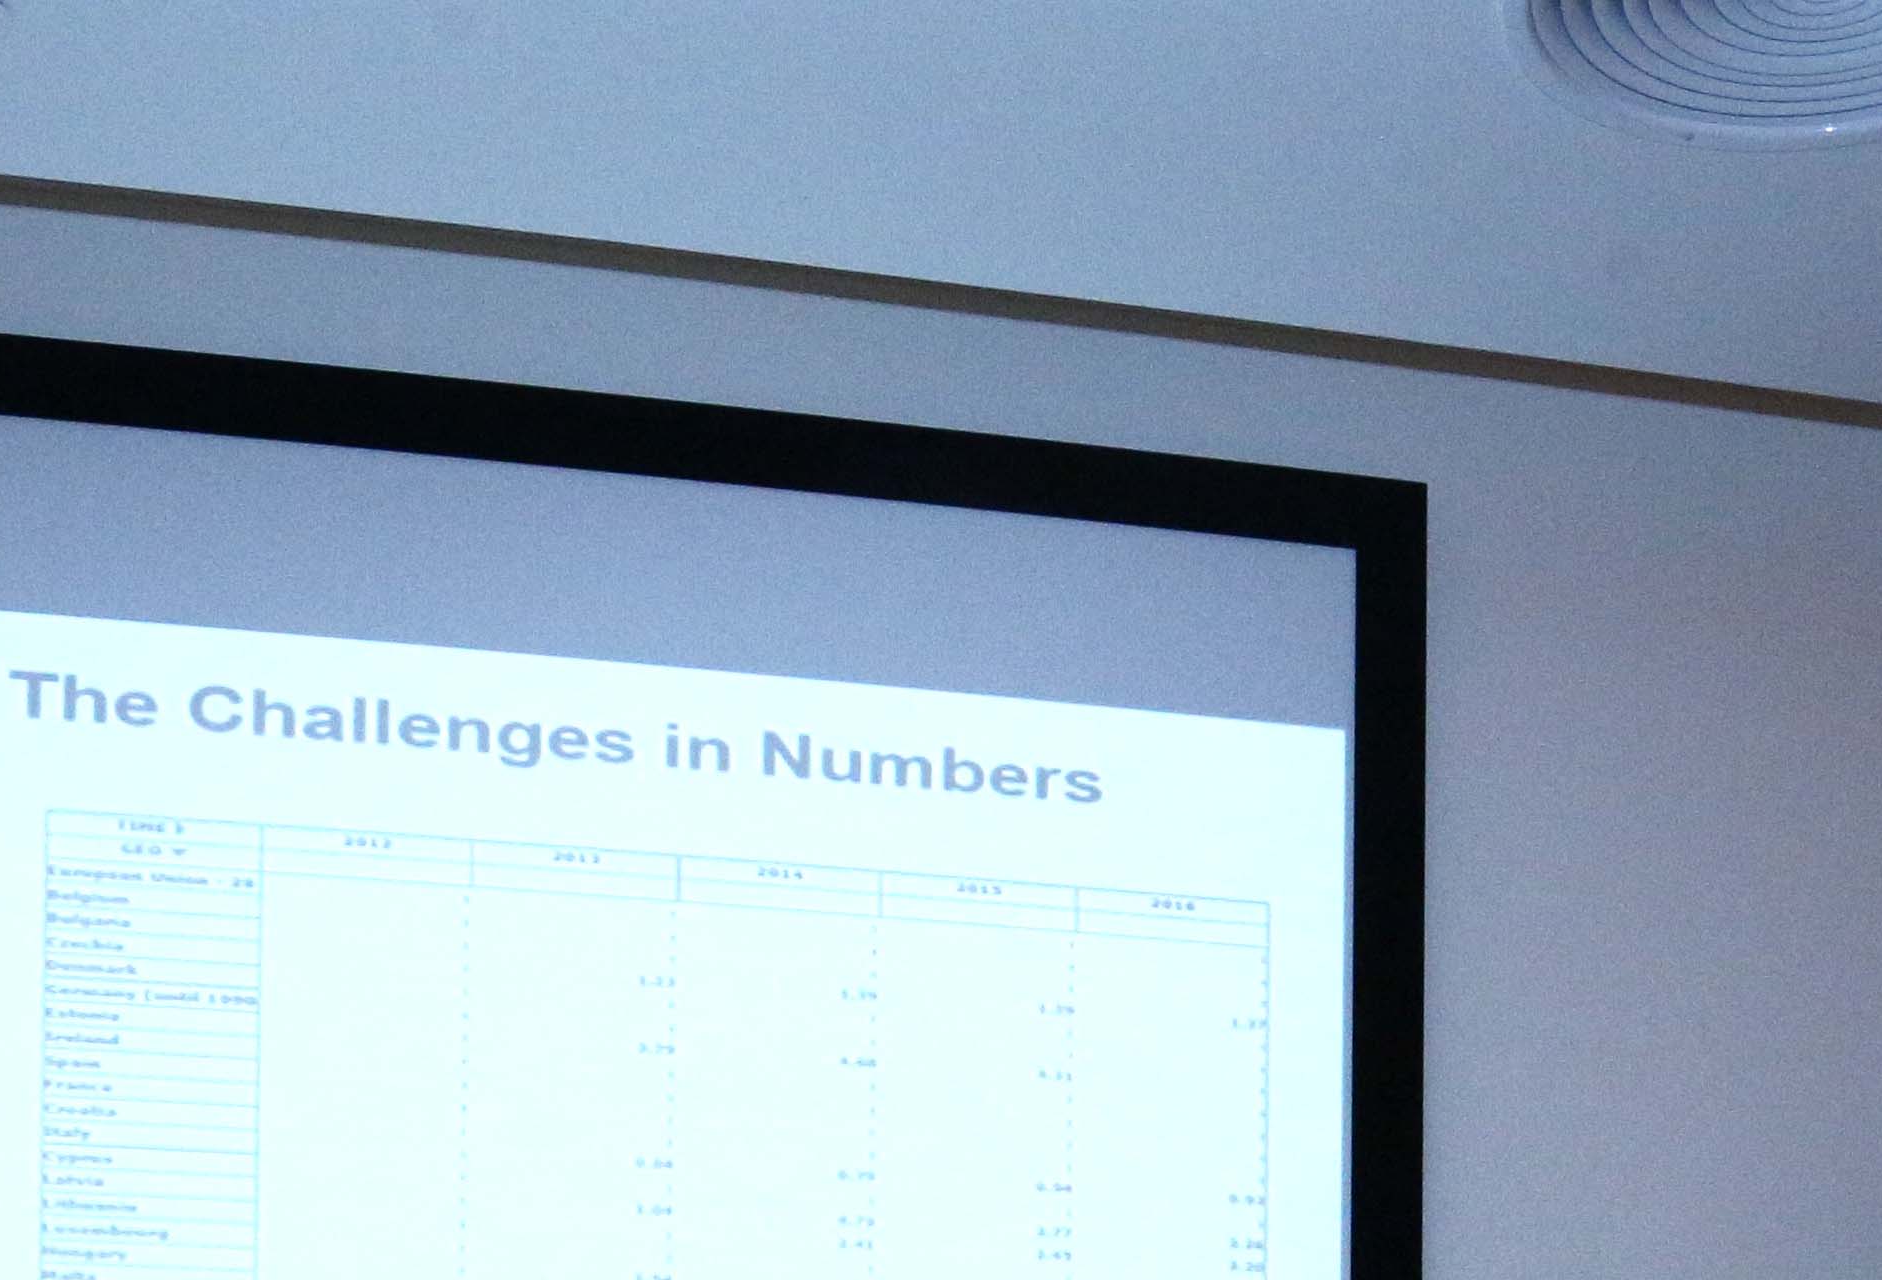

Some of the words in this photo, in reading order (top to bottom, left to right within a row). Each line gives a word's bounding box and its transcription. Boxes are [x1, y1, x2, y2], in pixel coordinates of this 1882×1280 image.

[7, 668, 159, 729] The
[187, 684, 635, 770] Challenges
[664, 721, 731, 774] in
[760, 729, 1103, 805] Numbers
